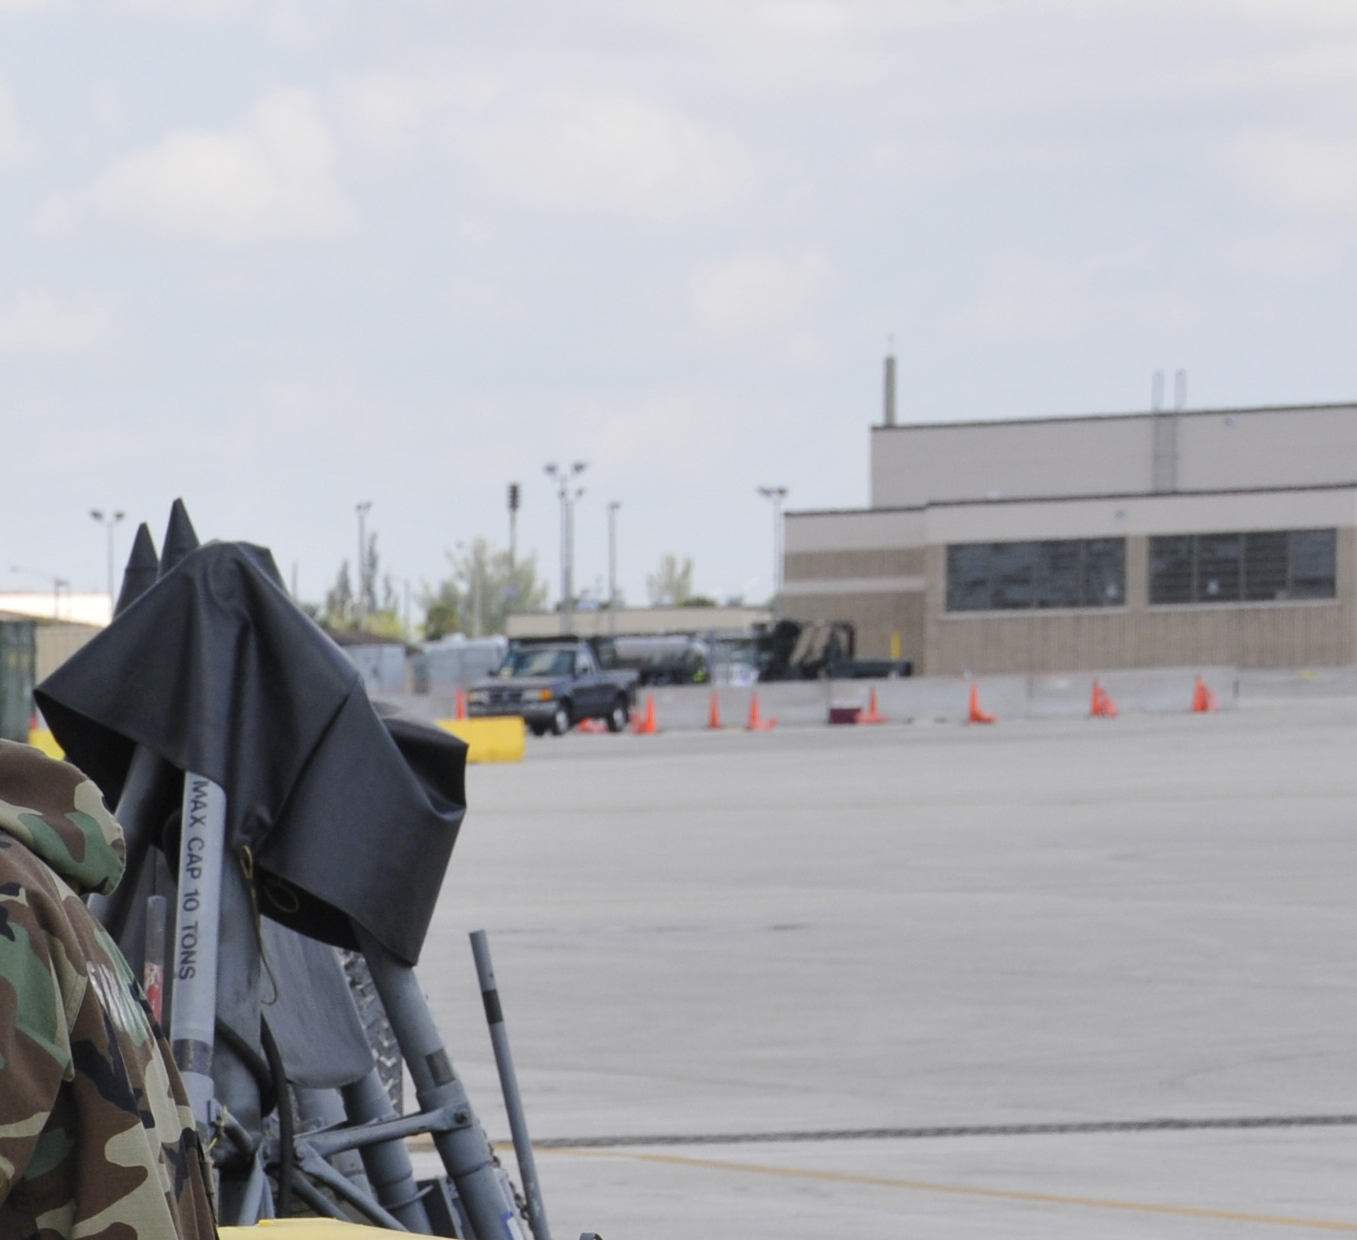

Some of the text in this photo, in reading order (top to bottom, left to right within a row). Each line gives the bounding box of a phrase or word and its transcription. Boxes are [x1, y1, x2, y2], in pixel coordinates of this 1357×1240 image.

[178, 780, 209, 980] MAX CAP 10 TONS
